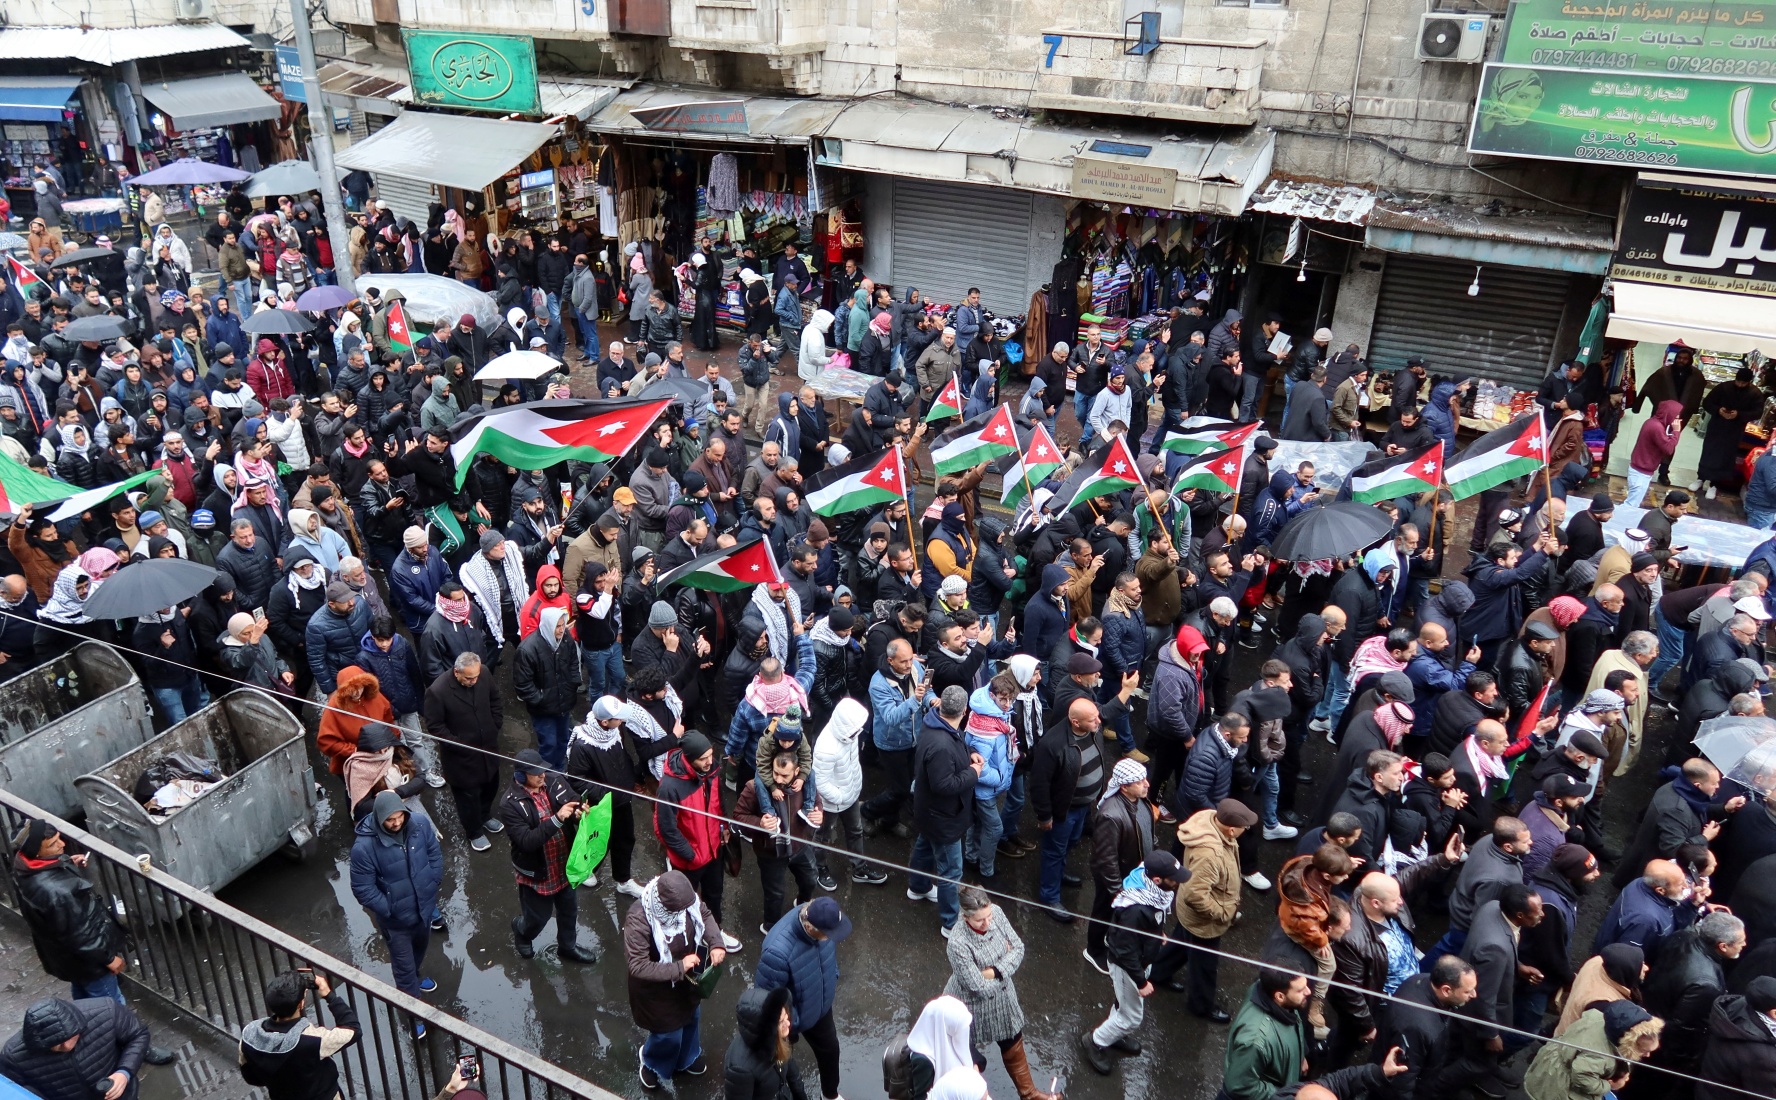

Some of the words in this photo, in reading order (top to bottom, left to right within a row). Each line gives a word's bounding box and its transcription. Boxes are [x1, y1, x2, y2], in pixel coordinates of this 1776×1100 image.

[1562, 2, 1626, 18] المحجبة
[1676, 8, 1709, 24] يلزم
[1715, 9, 1730, 22] ما
[1734, 10, 1764, 26] كل
[1529, 23, 1567, 41] صلاة
[1639, 31, 1704, 47] حجابات
[1043, 35, 1063, 68] 7
[1531, 48, 1638, 68] 0797444481
[281, 64, 302, 76] MAZE
[1589, 81, 1641, 97] الشالات
[1643, 86, 1689, 101] لتجارة
[1558, 103, 1600, 119] الصلاة
[1646, 109, 1717, 131] والحجابات
[1581, 128, 1621, 145] مفرق
[1643, 132, 1678, 147] جملة
[1575, 146, 1678, 165] 0792682626
[1100, 180, 1120, 188] HAMED
[1625, 247, 1657, 260] مفرق
